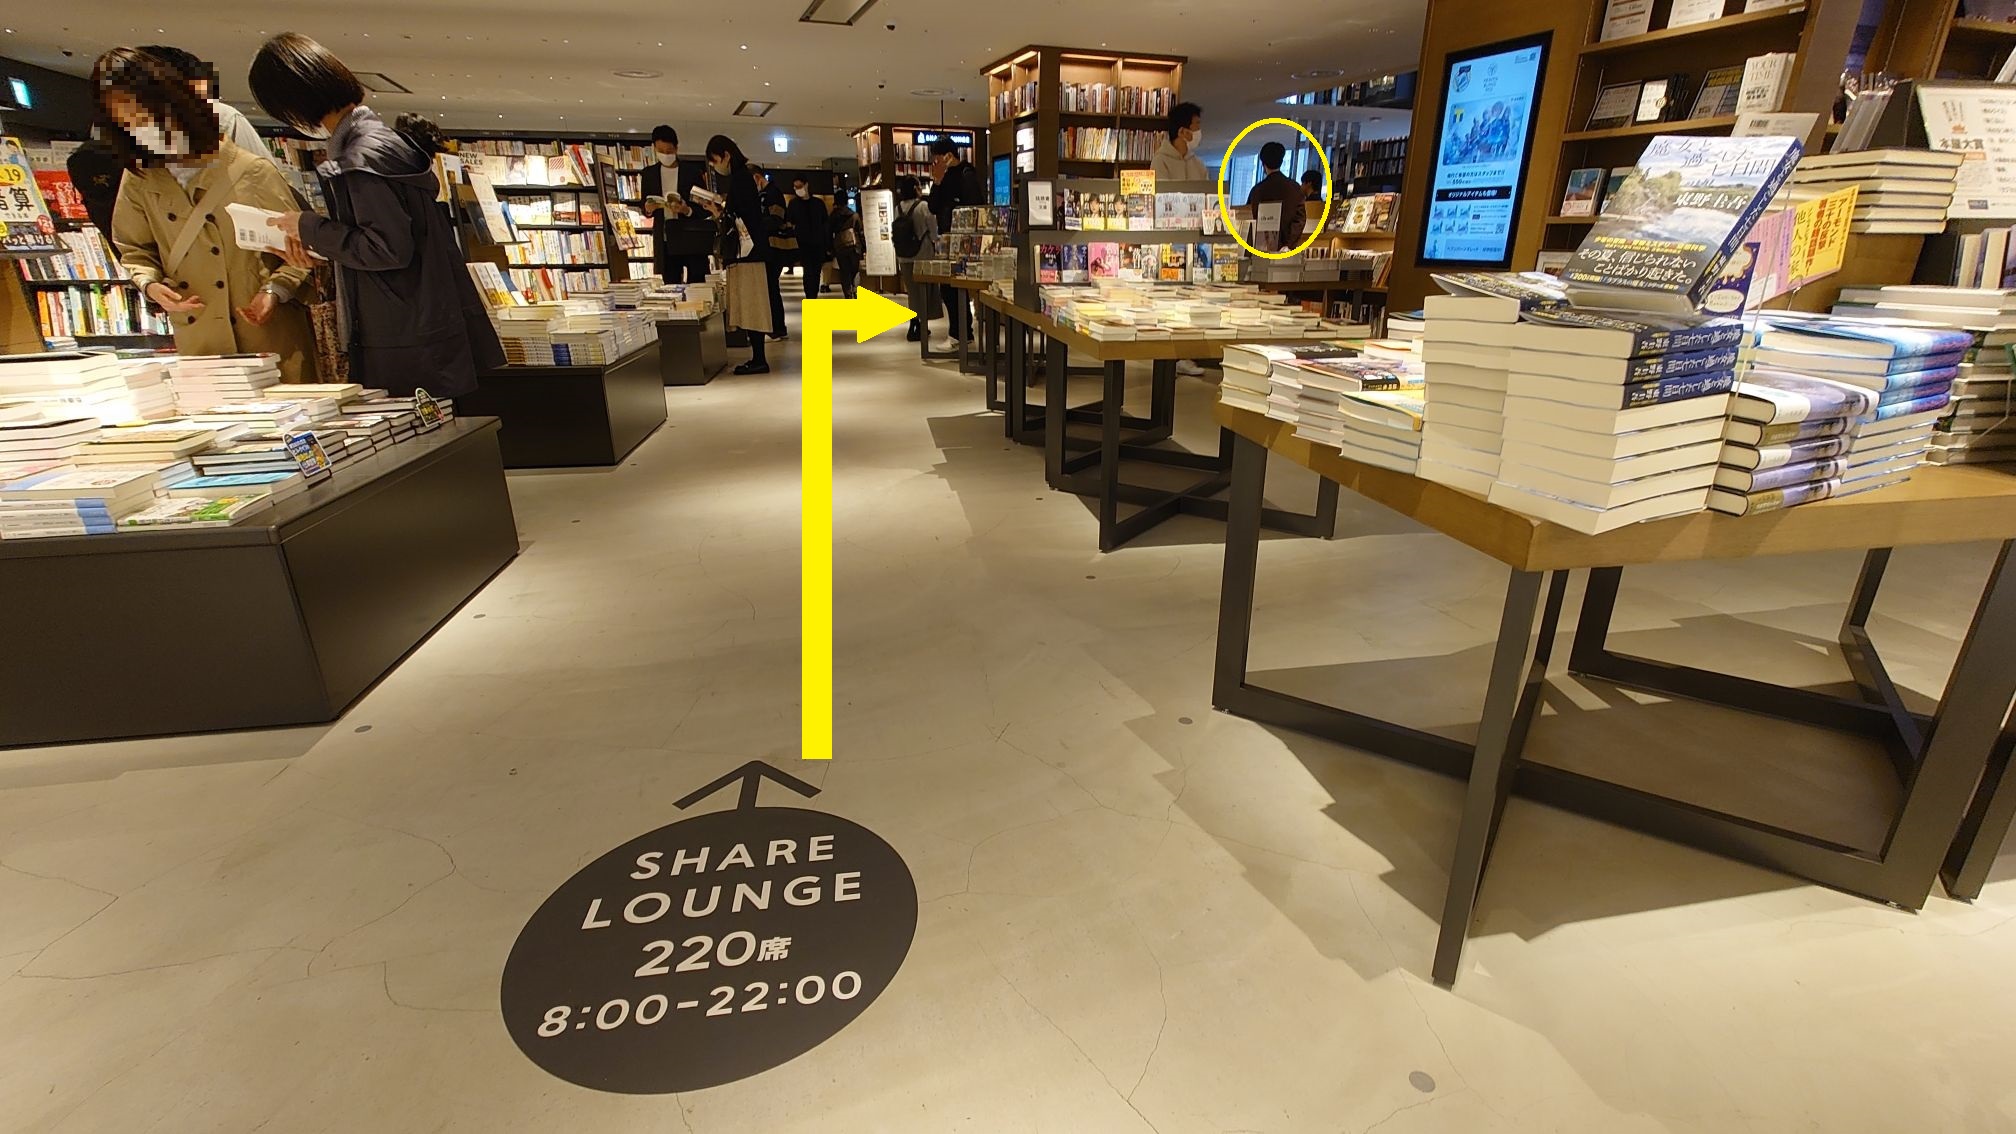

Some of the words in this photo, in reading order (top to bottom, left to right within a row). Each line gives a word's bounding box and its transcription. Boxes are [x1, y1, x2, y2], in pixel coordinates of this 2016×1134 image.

[1650, 138, 1712, 157] 魔女と
[1681, 149, 1753, 168] 過ごした
[1711, 158, 1777, 177] 七日間
[1674, 192, 1749, 210] 東野圭吾
[1828, 197, 1848, 249] アーモンド
[1578, 248, 1697, 268] その夏、信じられない
[1593, 262, 1693, 285] ことばかり起きた。
[630, 834, 835, 880] SHARE
[581, 871, 861, 930] LOUNGE
[634, 930, 792, 978] 220席
[537, 970, 862, 1038] 8:00-22:00
